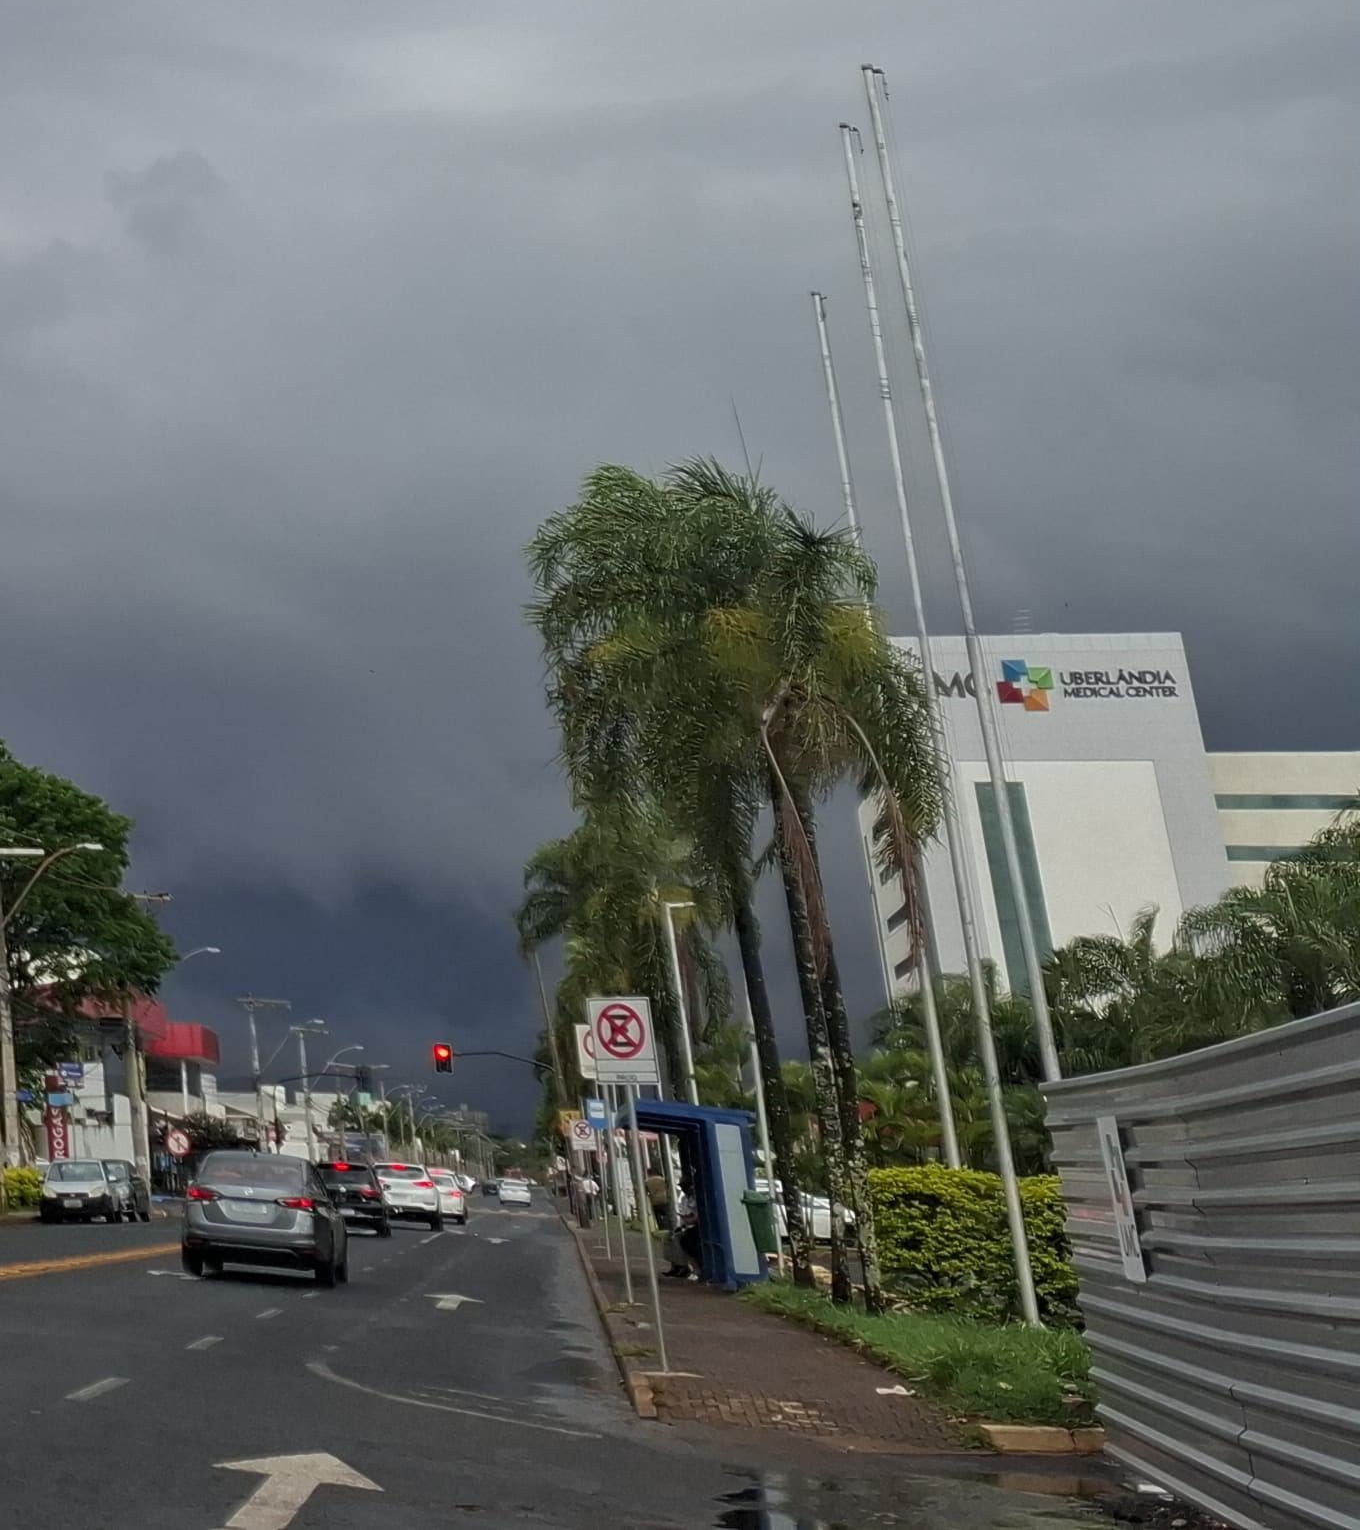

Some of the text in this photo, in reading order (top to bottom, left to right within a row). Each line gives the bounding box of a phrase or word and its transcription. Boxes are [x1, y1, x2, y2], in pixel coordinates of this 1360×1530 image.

[932, 672, 990, 698] MC
[1060, 669, 1176, 685] UBERLÂNDIA
[1064, 686, 1178, 698] MEDICAL CENTER
[52, 1106, 66, 1159] ROGAS
